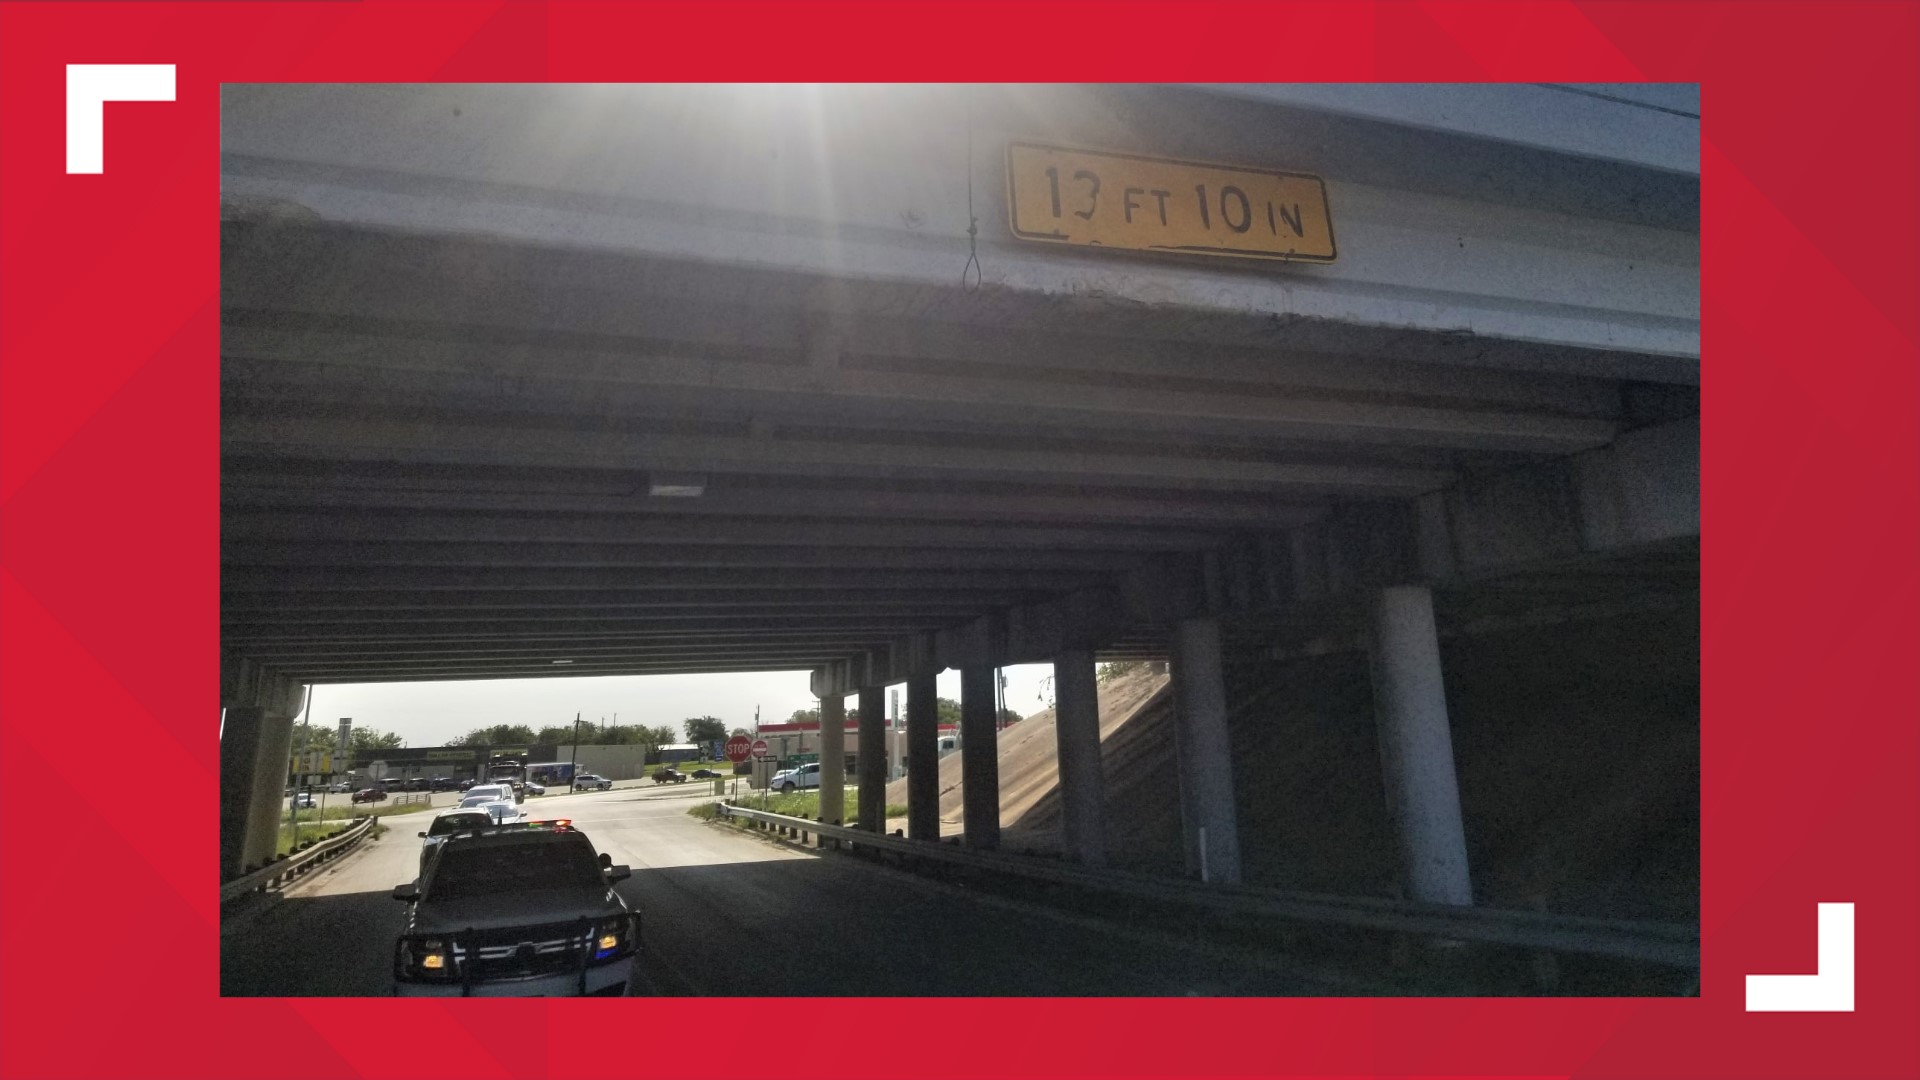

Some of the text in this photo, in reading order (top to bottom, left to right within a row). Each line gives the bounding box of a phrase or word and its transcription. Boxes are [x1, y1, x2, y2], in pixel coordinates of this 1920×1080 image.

[1046, 167, 1304, 238] 13 FT 10 IN
[728, 744, 750, 755] STOP
